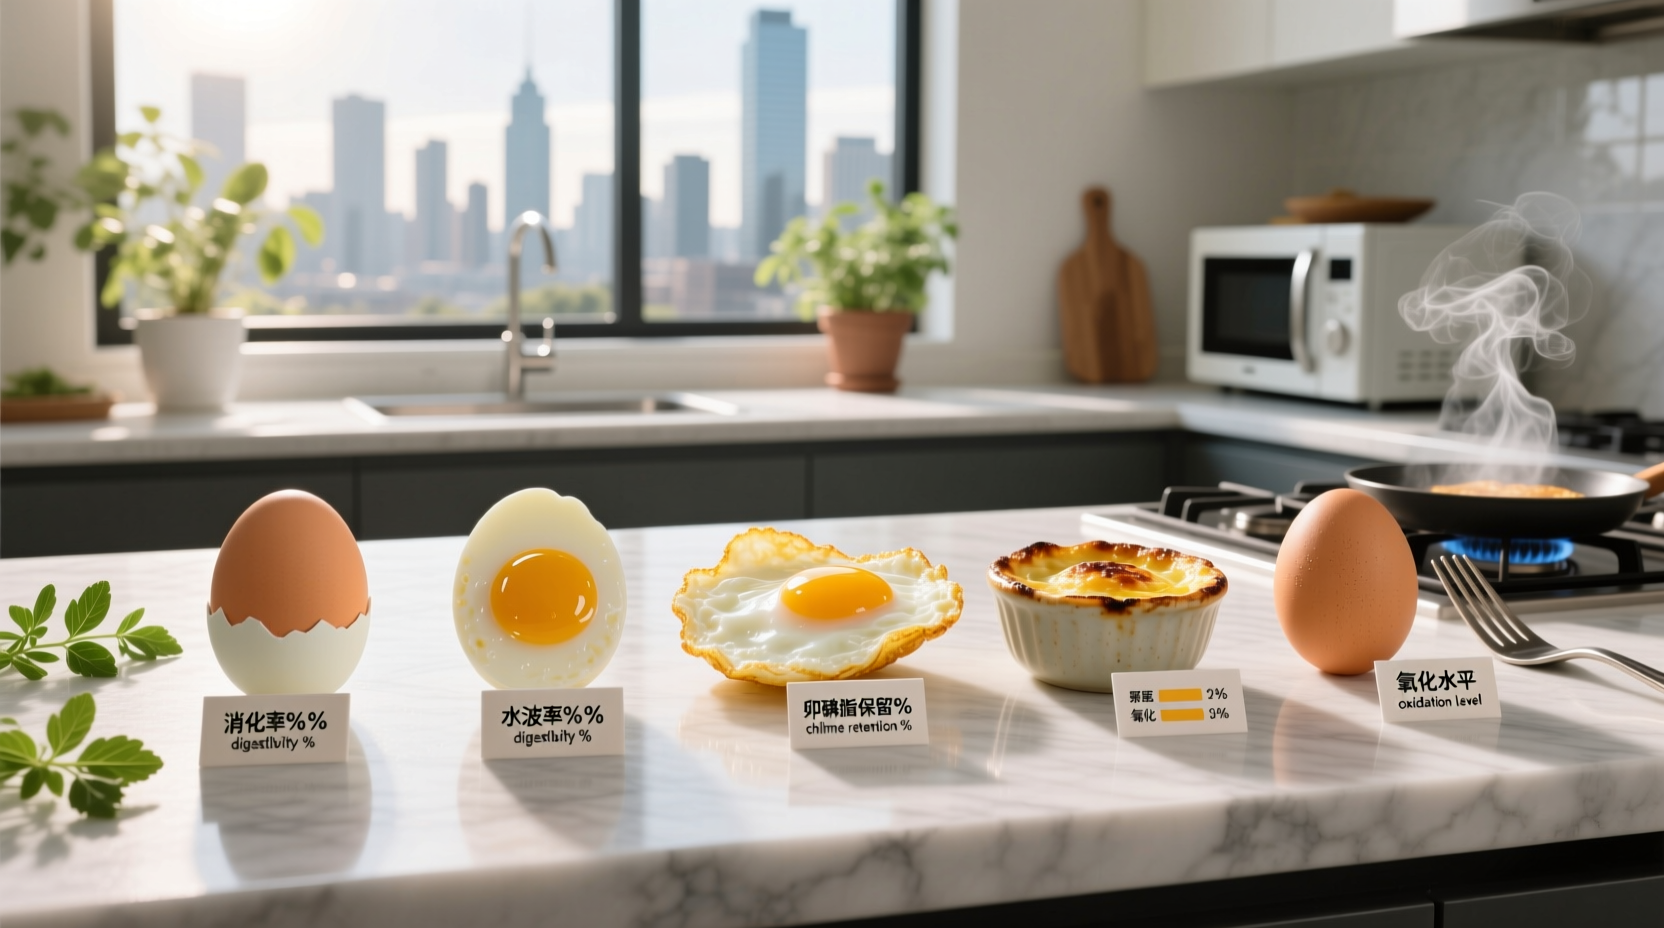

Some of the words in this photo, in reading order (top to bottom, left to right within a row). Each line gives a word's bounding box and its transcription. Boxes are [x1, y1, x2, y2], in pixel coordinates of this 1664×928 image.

[1396, 670, 1476, 693] 氧化水平
[1398, 696, 1452, 709] oxidation
[1455, 693, 1482, 707] level
[900, 719, 912, 731] %
[302, 735, 316, 749] %
[578, 729, 592, 742] %
